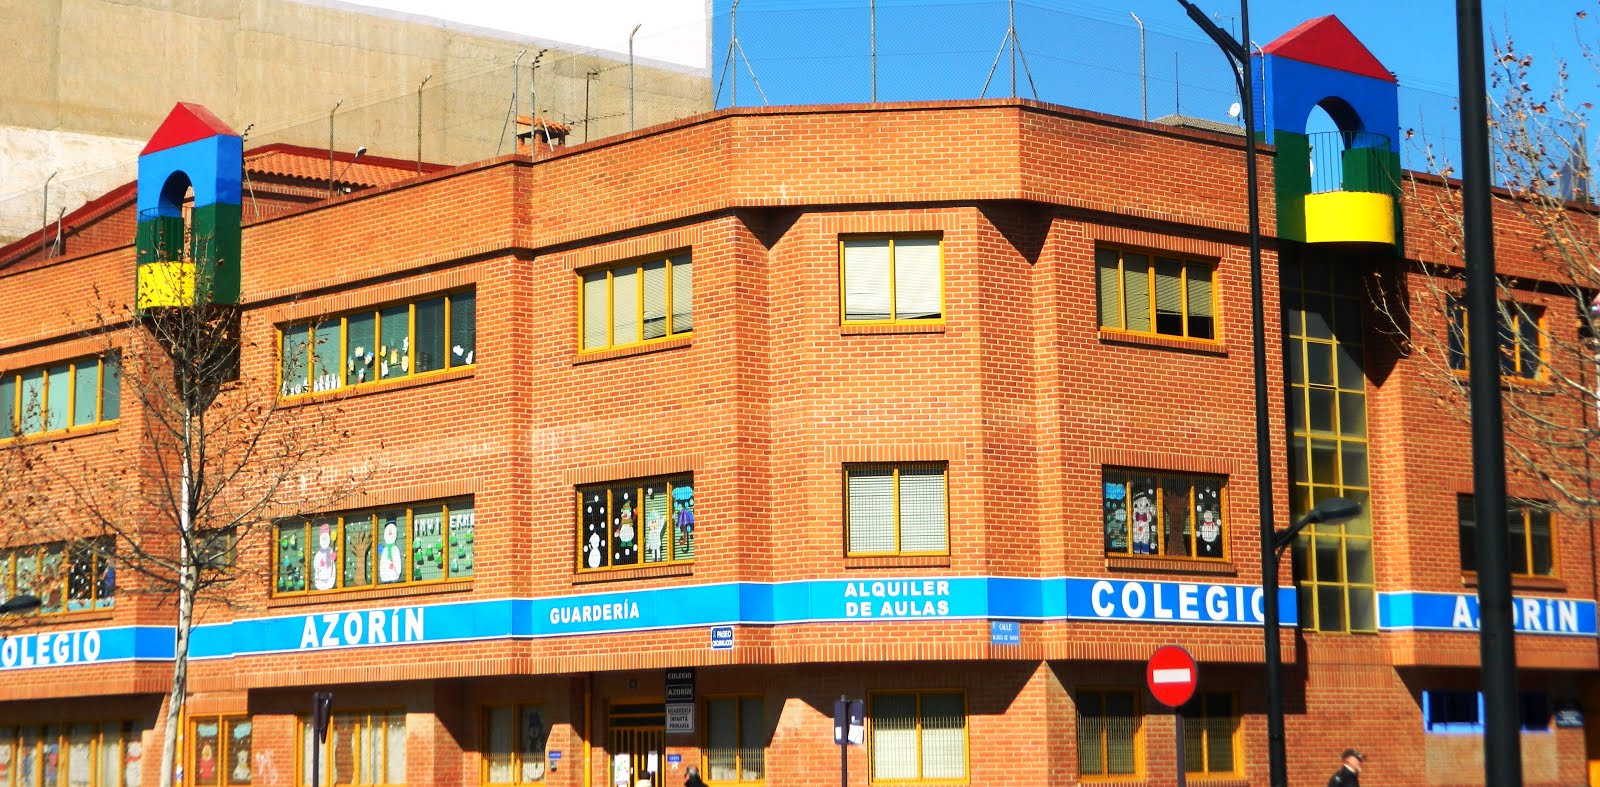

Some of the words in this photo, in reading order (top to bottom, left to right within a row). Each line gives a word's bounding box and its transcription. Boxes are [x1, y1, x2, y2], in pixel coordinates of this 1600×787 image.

[844, 581, 950, 597] ALQUILER
[549, 599, 640, 625] GUARDERÍA
[846, 602, 872, 617] DE
[880, 600, 950, 616] AULAS
[1452, 595, 1579, 632] ARÍN
[717, 630, 732, 638] PASEO
